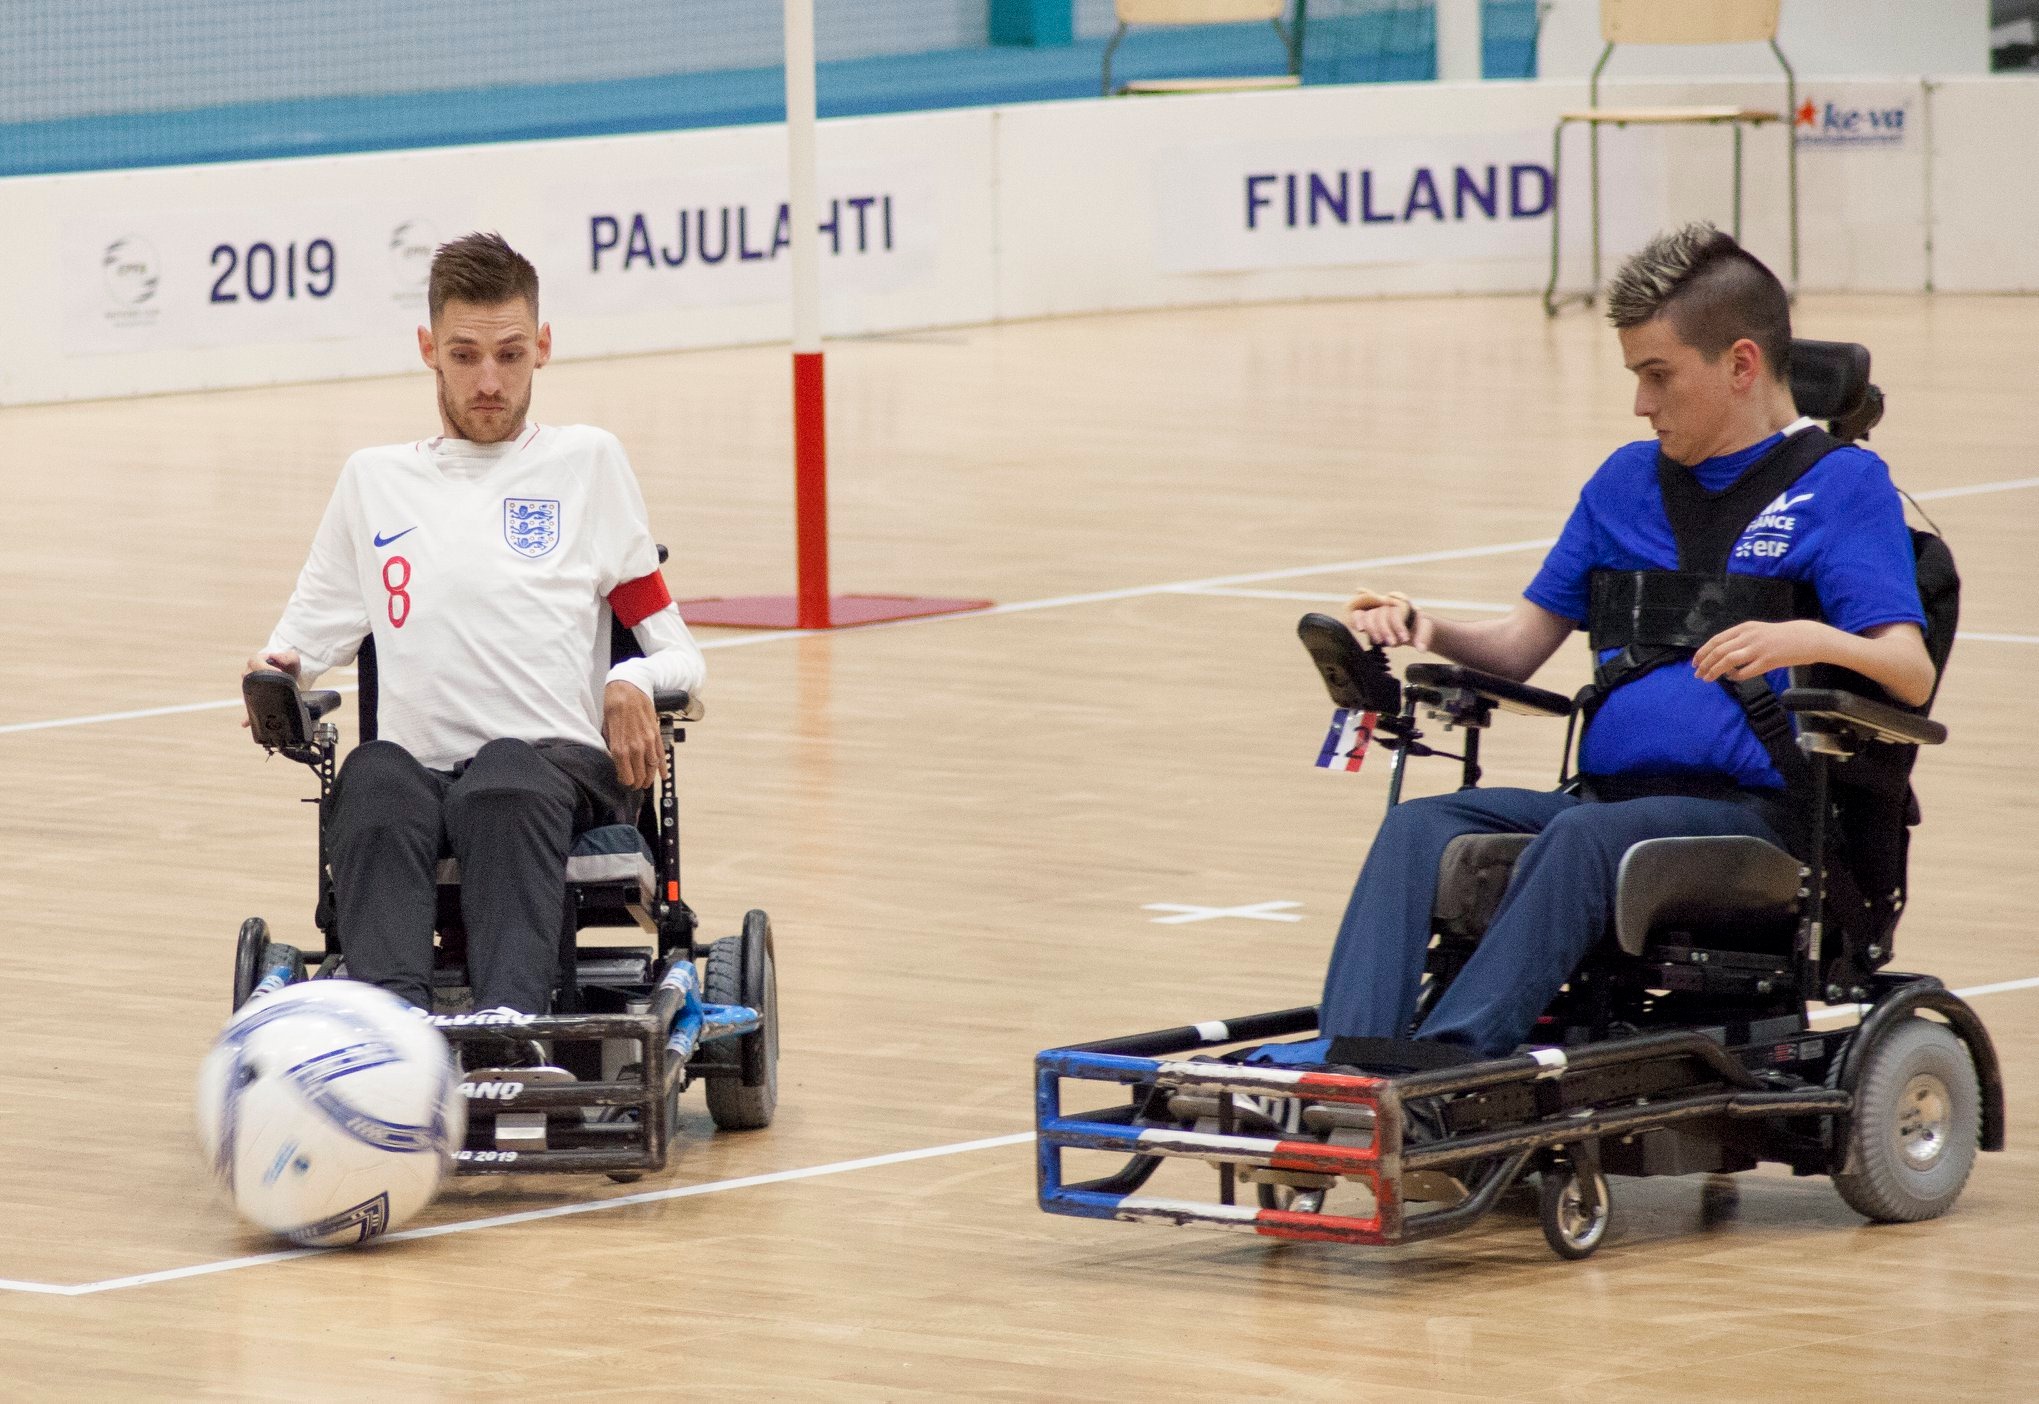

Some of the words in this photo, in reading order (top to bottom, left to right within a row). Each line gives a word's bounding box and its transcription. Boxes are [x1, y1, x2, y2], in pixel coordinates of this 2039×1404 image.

[1244, 162, 1556, 230] FINLAND
[208, 237, 336, 304] 2019
[1744, 514, 1797, 533] ANCE
[382, 555, 412, 629] 8
